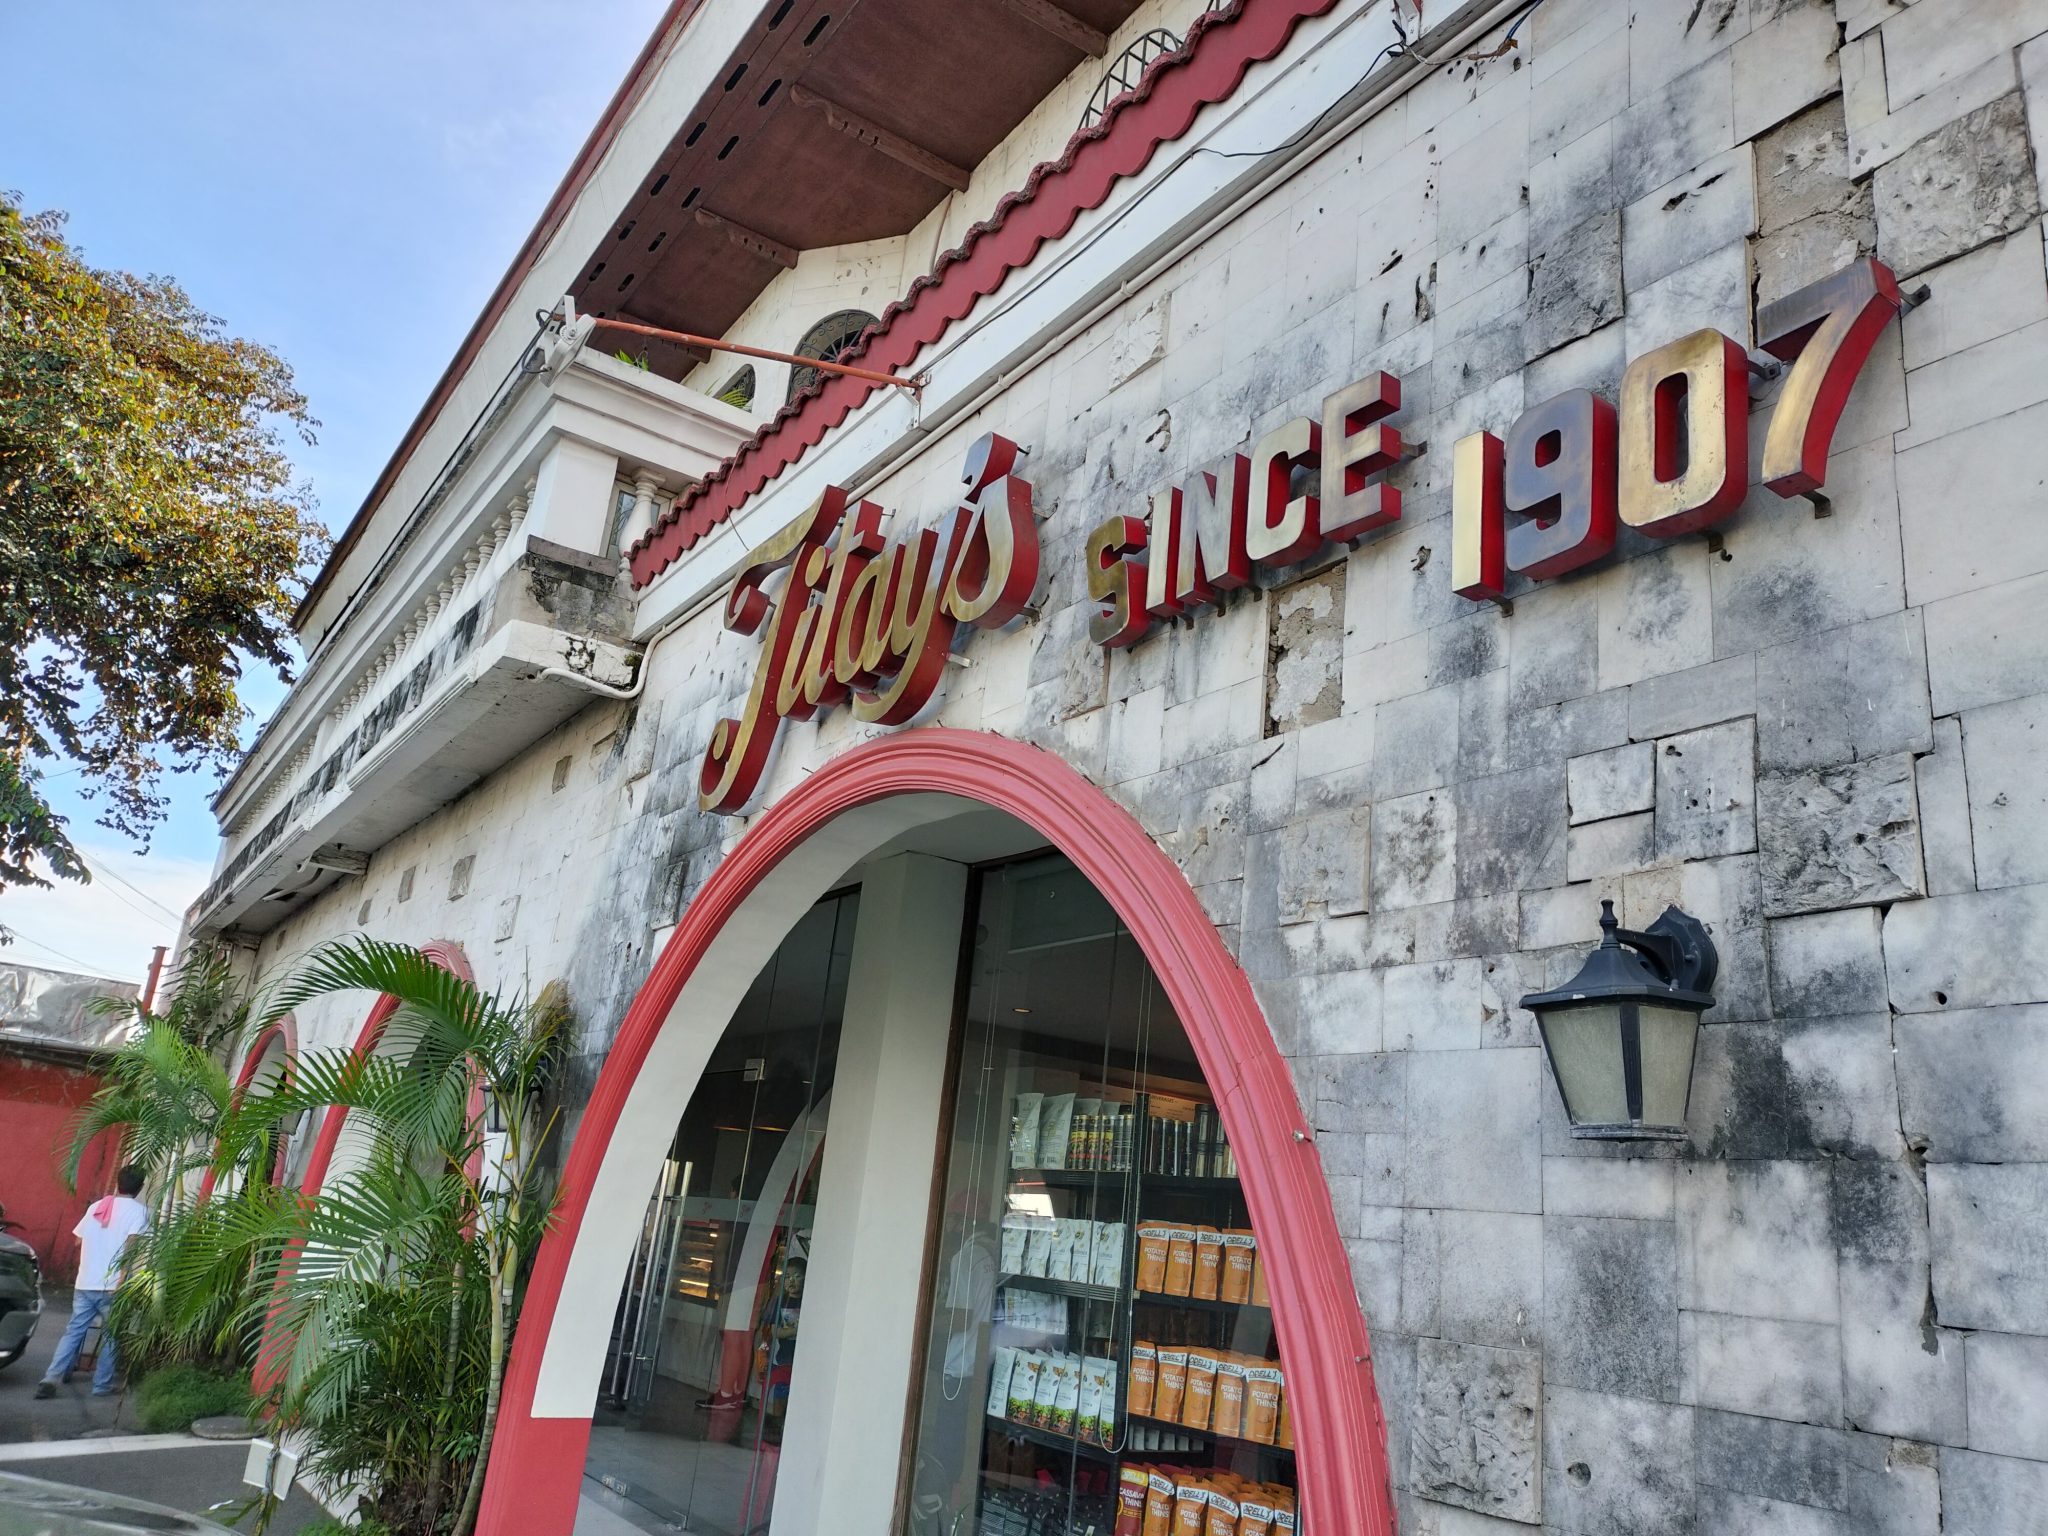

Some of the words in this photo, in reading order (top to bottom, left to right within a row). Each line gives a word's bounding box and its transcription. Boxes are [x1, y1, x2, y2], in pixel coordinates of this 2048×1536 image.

[698, 431, 1039, 816] Titay's
[1086, 371, 1400, 649] SINCE
[1452, 256, 1902, 602] 1907
[1162, 1372, 1185, 1383] POTATO
[1164, 1380, 1185, 1391] THINS
[1190, 1378, 1212, 1389] POTATO
[1191, 1386, 1212, 1397] THINS
[1220, 1384, 1243, 1395] POTATO
[1252, 1390, 1277, 1401] POTATO
[1255, 1398, 1277, 1409] THINS
[1151, 1508, 1169, 1518] THINS
